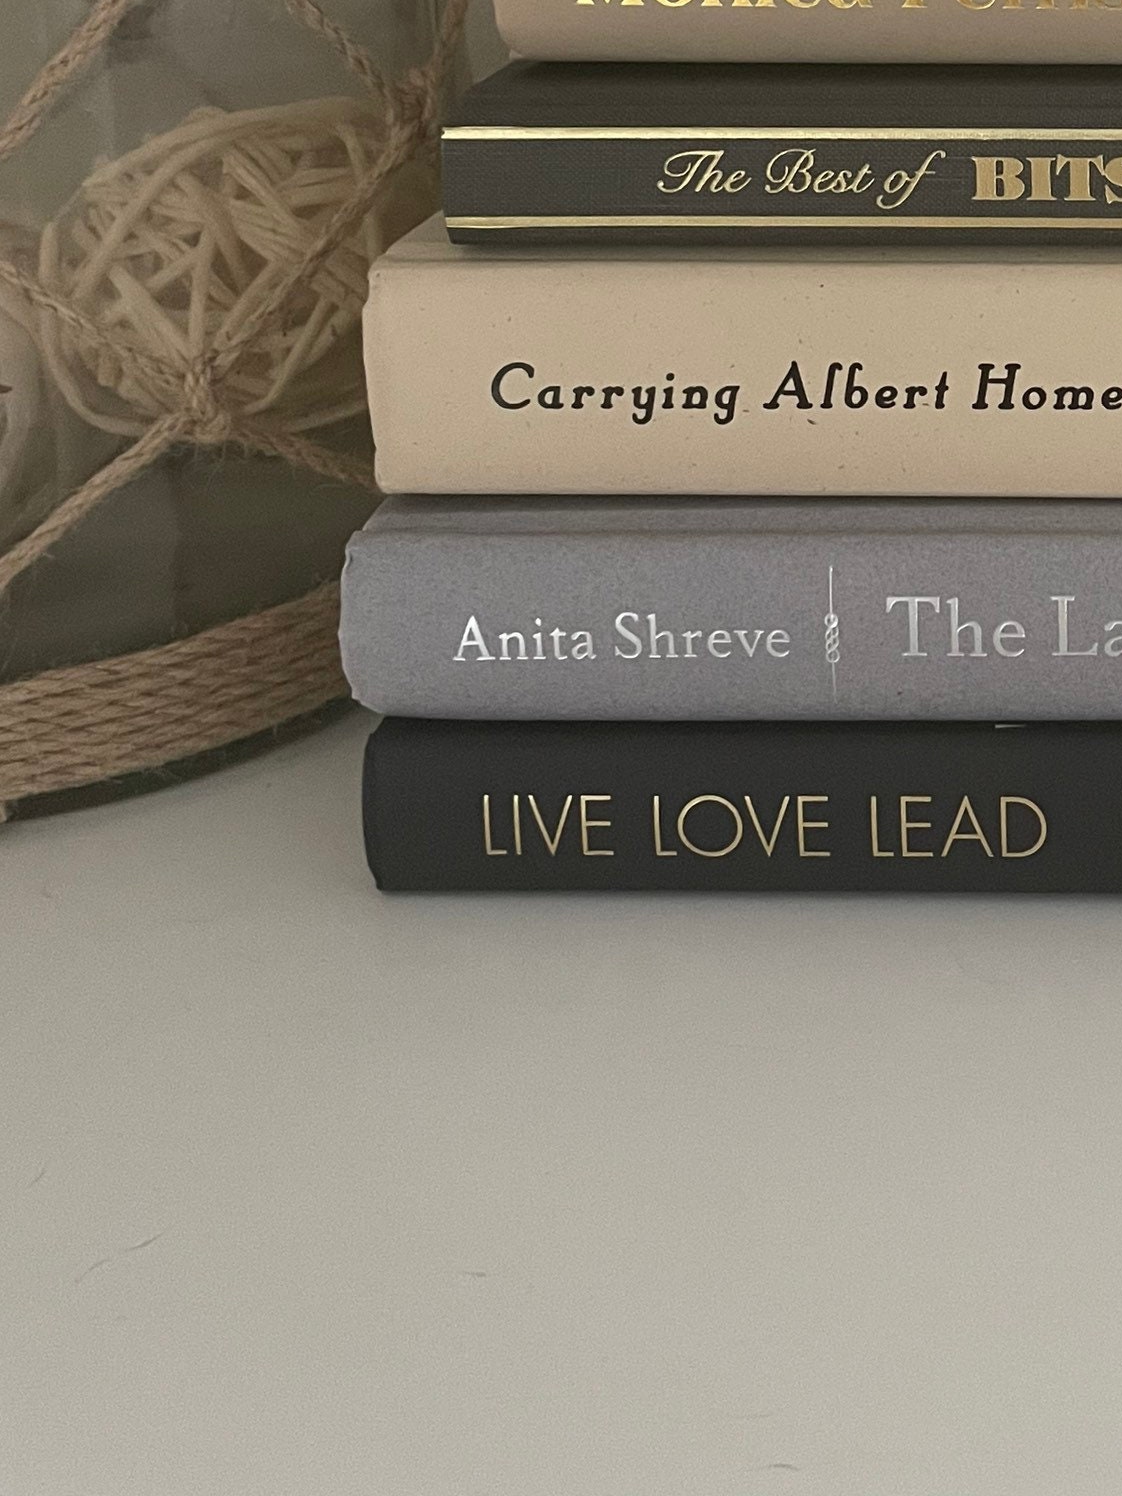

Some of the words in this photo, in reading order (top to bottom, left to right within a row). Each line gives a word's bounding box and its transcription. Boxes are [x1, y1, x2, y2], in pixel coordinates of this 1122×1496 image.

[655, 149, 752, 196] The
[764, 147, 874, 196] Best
[875, 149, 947, 210] of
[489, 361, 742, 426] Carrying
[761, 360, 950, 412] Albert
[452, 614, 597, 662] Anita
[613, 611, 792, 661] Shreve
[885, 595, 1027, 658] The
[482, 794, 615, 857] LIVE
[652, 794, 831, 858] LOVE
[870, 795, 1048, 859] LEAD
